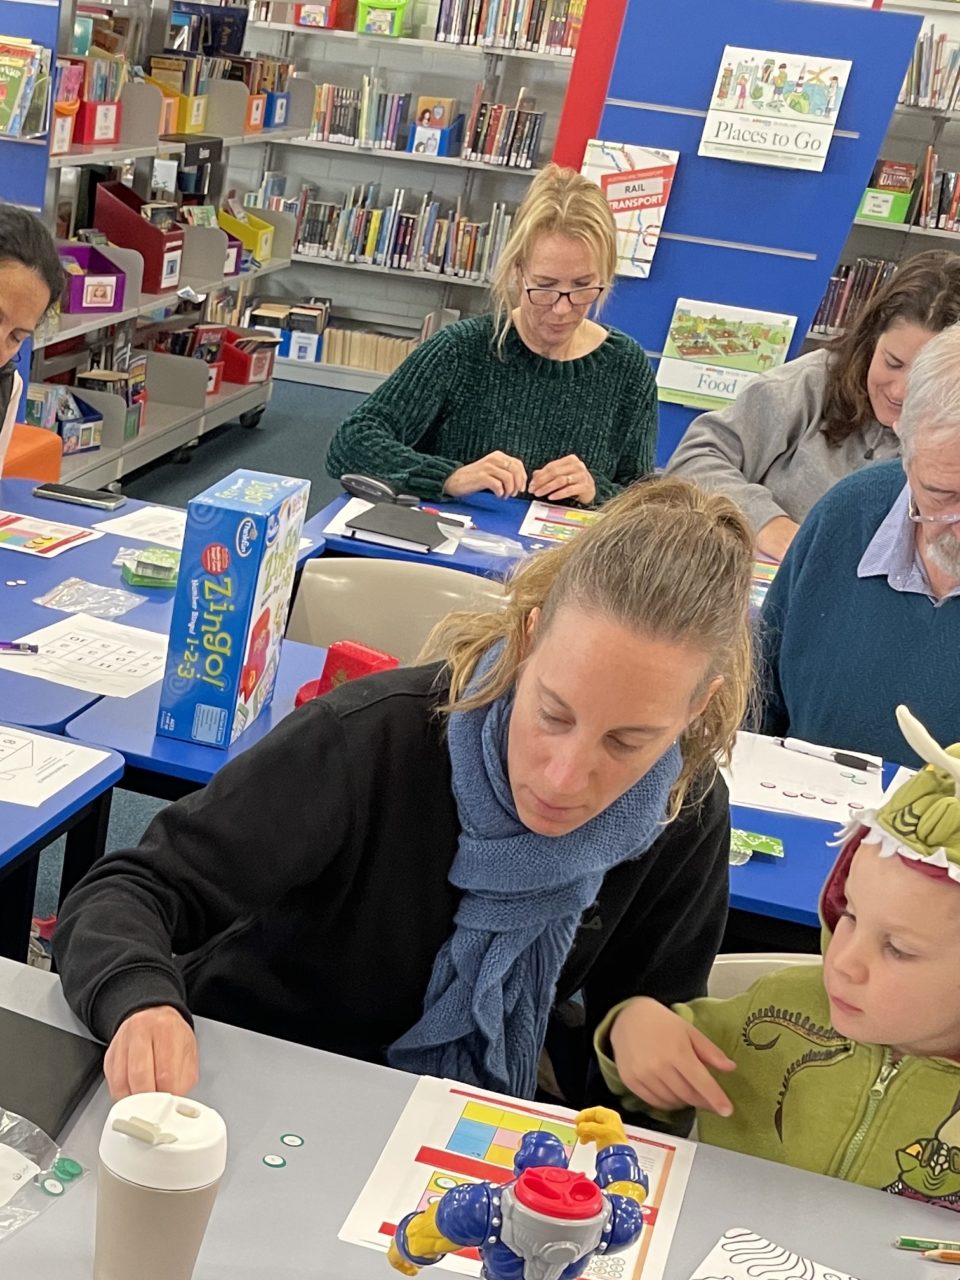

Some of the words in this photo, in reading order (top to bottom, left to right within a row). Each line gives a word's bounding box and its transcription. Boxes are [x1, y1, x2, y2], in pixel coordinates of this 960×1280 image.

[714, 121, 768, 144] Places
[772, 132, 790, 147] to
[794, 131, 822, 151] Go
[624, 183, 646, 194] RAIL
[608, 195, 664, 210] TRANSPORT
[697, 373, 738, 394] Food
[197, 577, 236, 689] Zingo!
